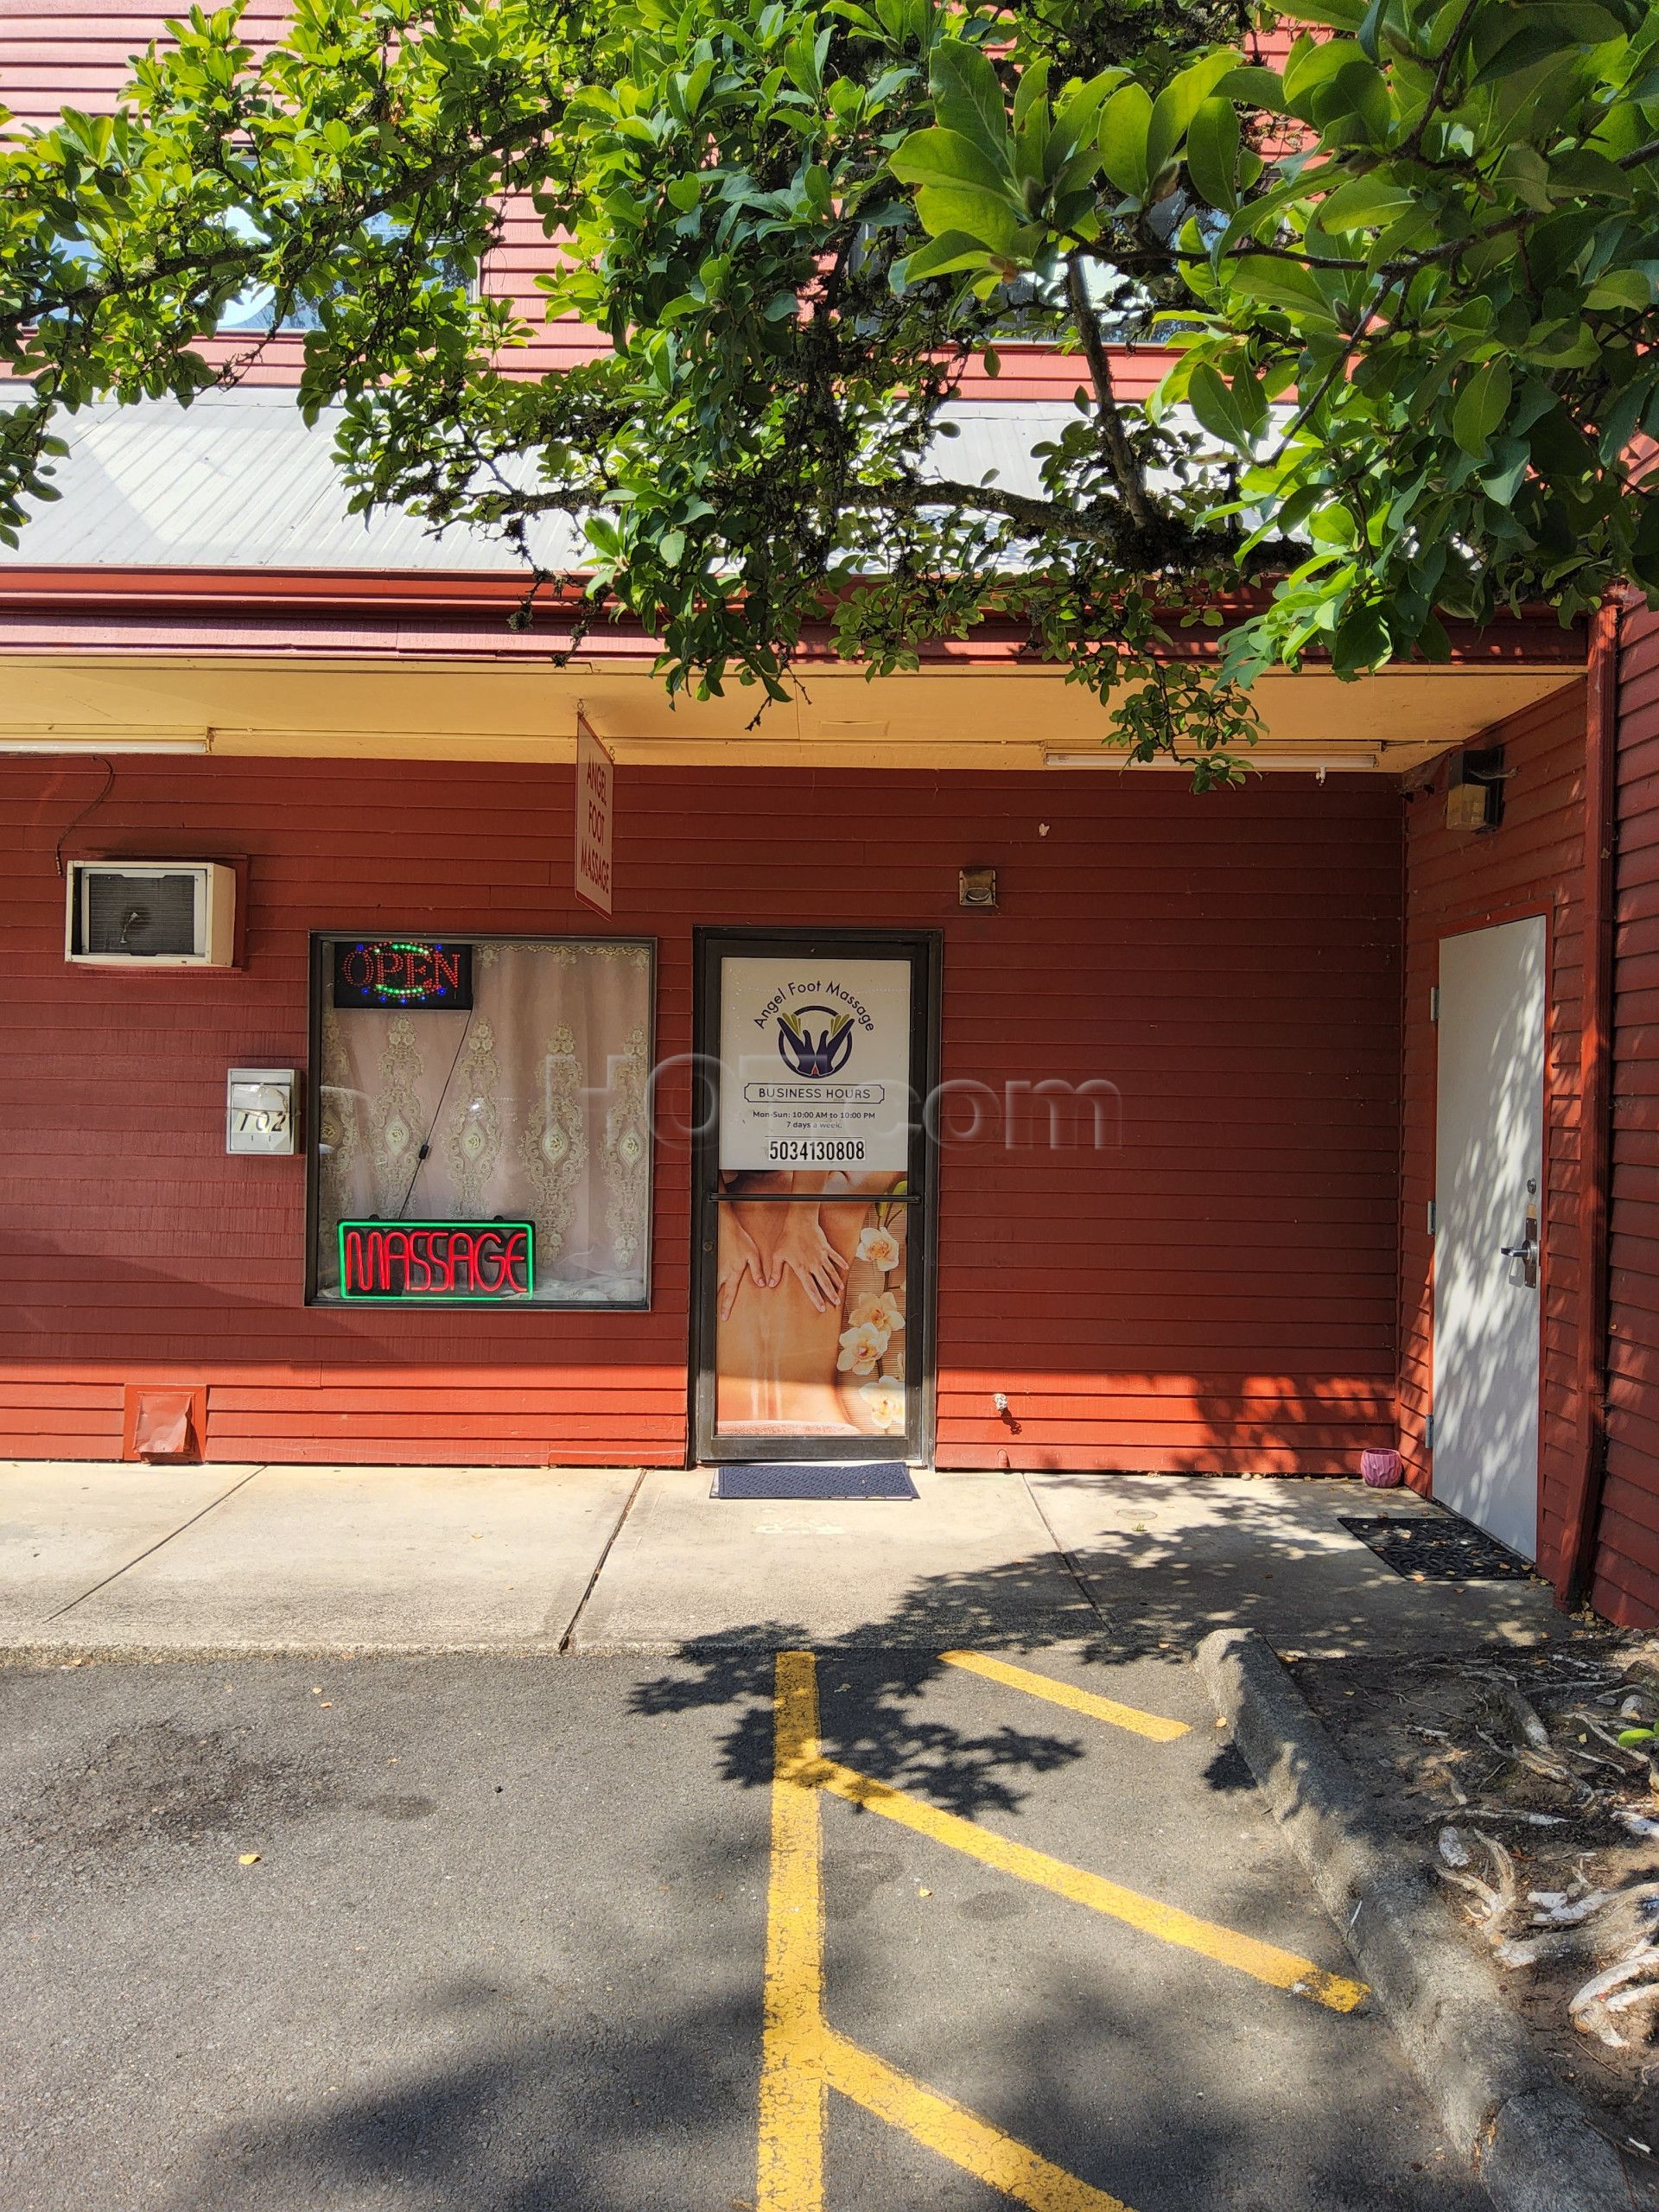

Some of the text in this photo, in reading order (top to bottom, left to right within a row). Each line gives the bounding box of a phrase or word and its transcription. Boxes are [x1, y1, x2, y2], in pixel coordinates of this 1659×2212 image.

[586, 754, 607, 808] ANGEL
[588, 799, 606, 847] FOOT
[580, 836, 610, 894] MASSAGE
[342, 950, 461, 989] OPEN
[753, 980, 875, 1032] Angel Foot Massage
[753, 1110, 791, 1119] Mon-Sun:
[758, 1087, 871, 1099] BUSINESS HOURS
[792, 1121, 811, 1130] days
[769, 1141, 865, 1160] 5034130808
[346, 1230, 528, 1294] MASSAGE
